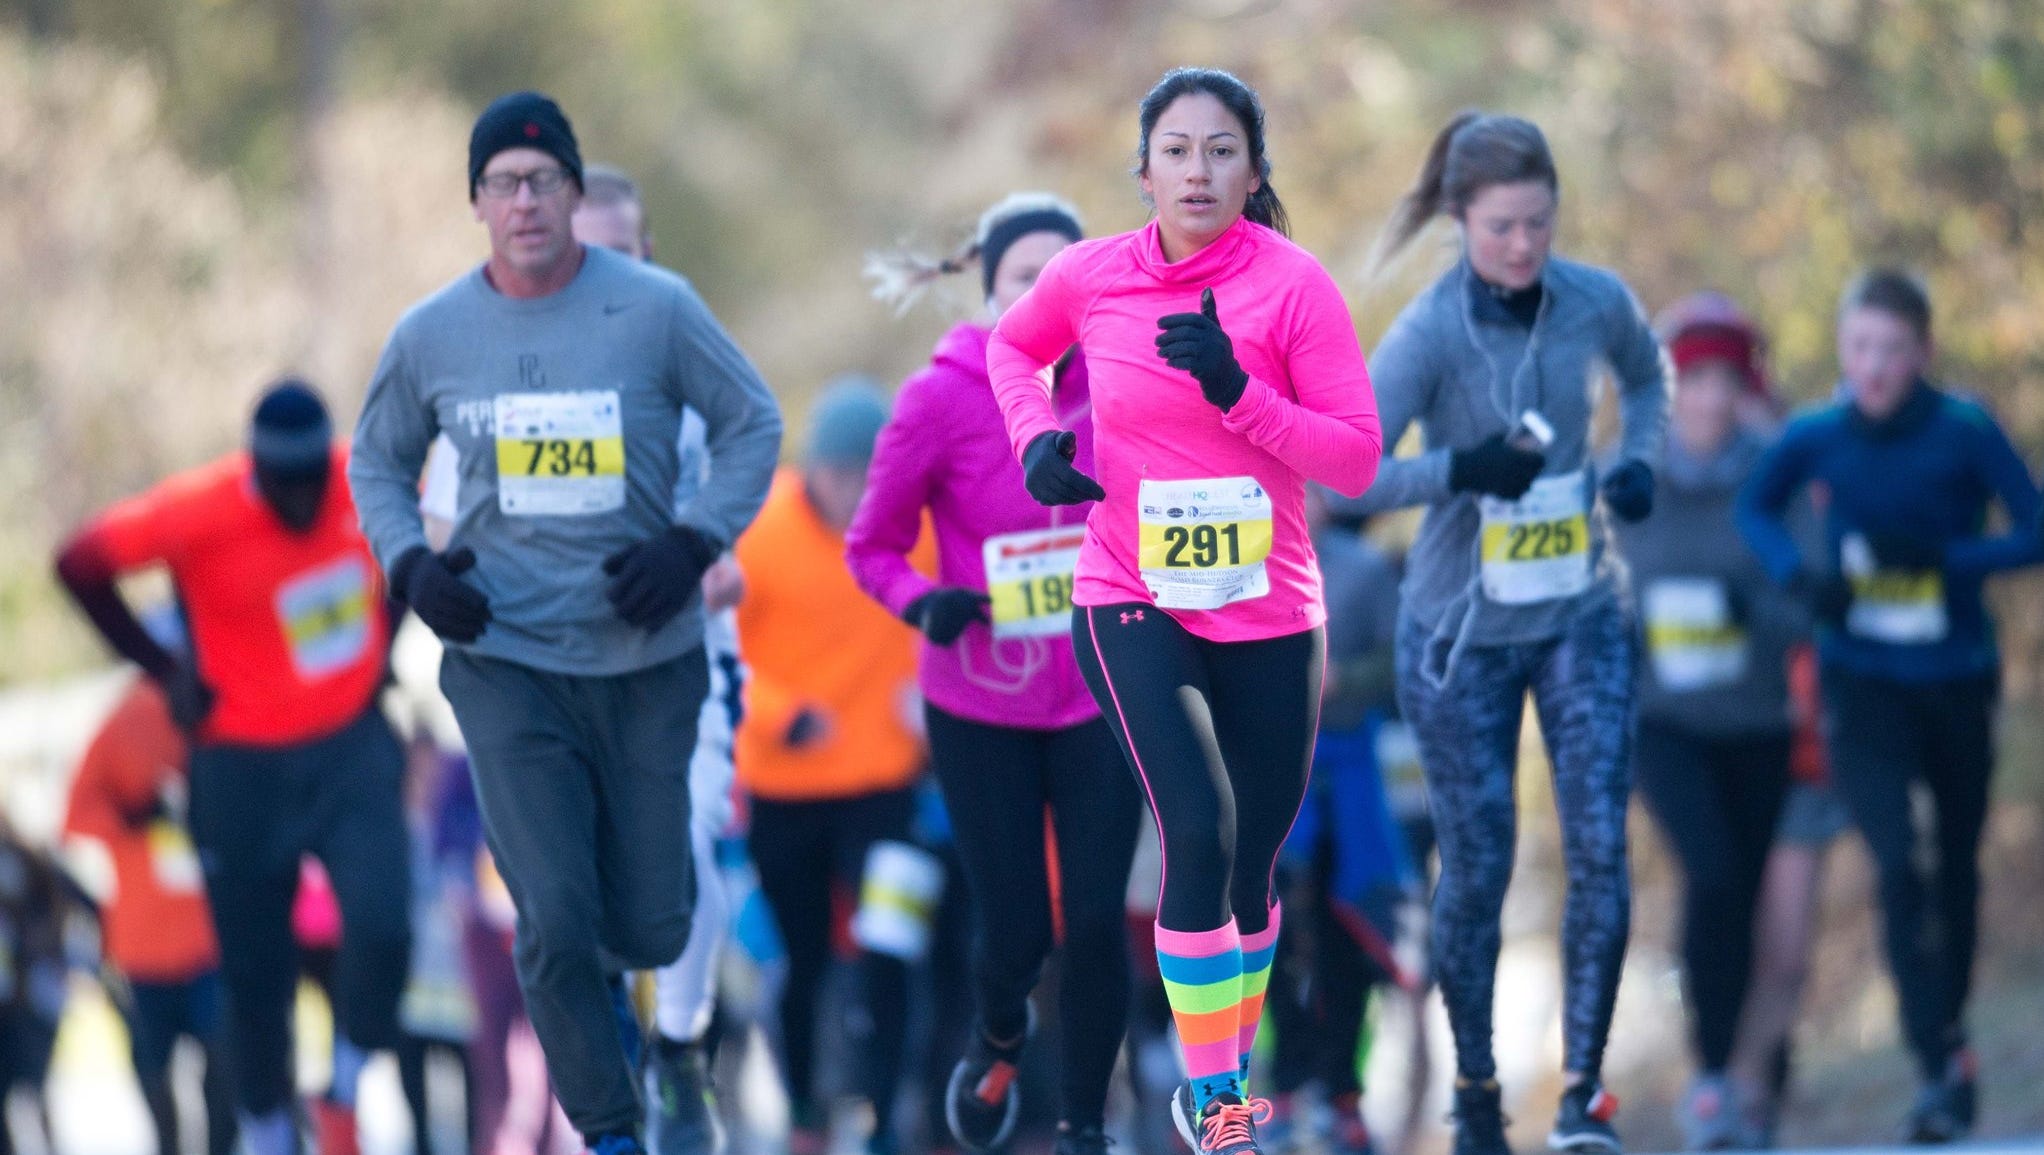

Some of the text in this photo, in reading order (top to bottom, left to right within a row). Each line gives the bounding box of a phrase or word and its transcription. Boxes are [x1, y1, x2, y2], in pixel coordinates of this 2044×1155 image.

[522, 440, 596, 475] 734
[1164, 523, 1240, 567] 291
[1509, 517, 1573, 559] 225
